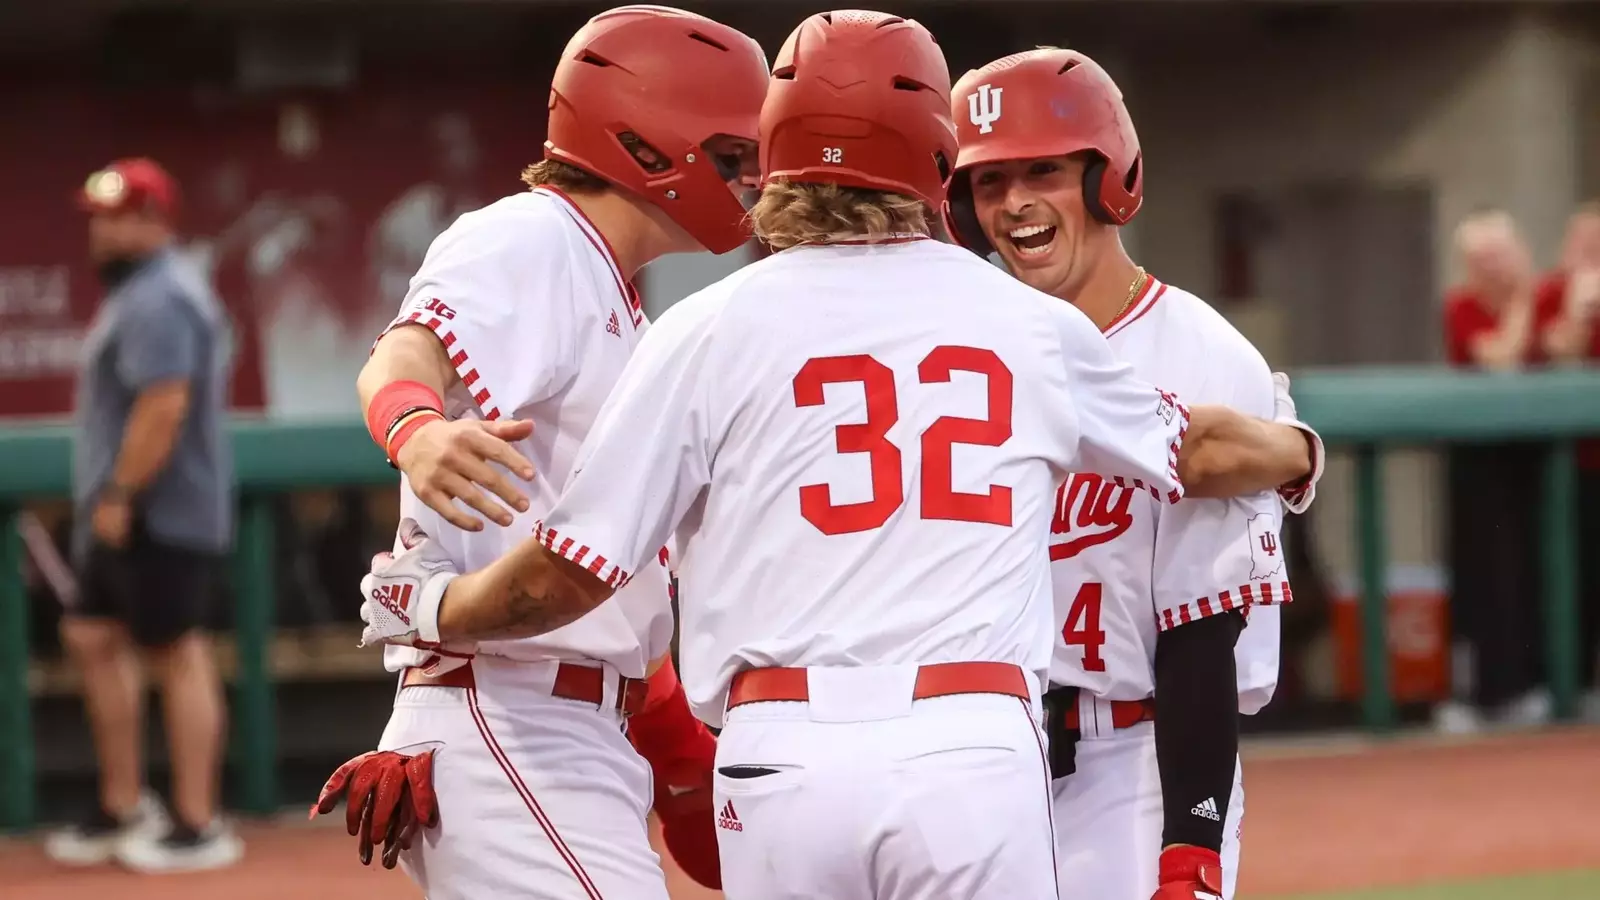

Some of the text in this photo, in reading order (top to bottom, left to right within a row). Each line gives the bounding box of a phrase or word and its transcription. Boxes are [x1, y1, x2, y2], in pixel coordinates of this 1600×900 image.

[822, 147, 842, 163] 32
[792, 345, 1013, 536] 32
[372, 588, 411, 627] adidas
[1062, 582, 1105, 672] 4
[1191, 807, 1220, 821] adidas
